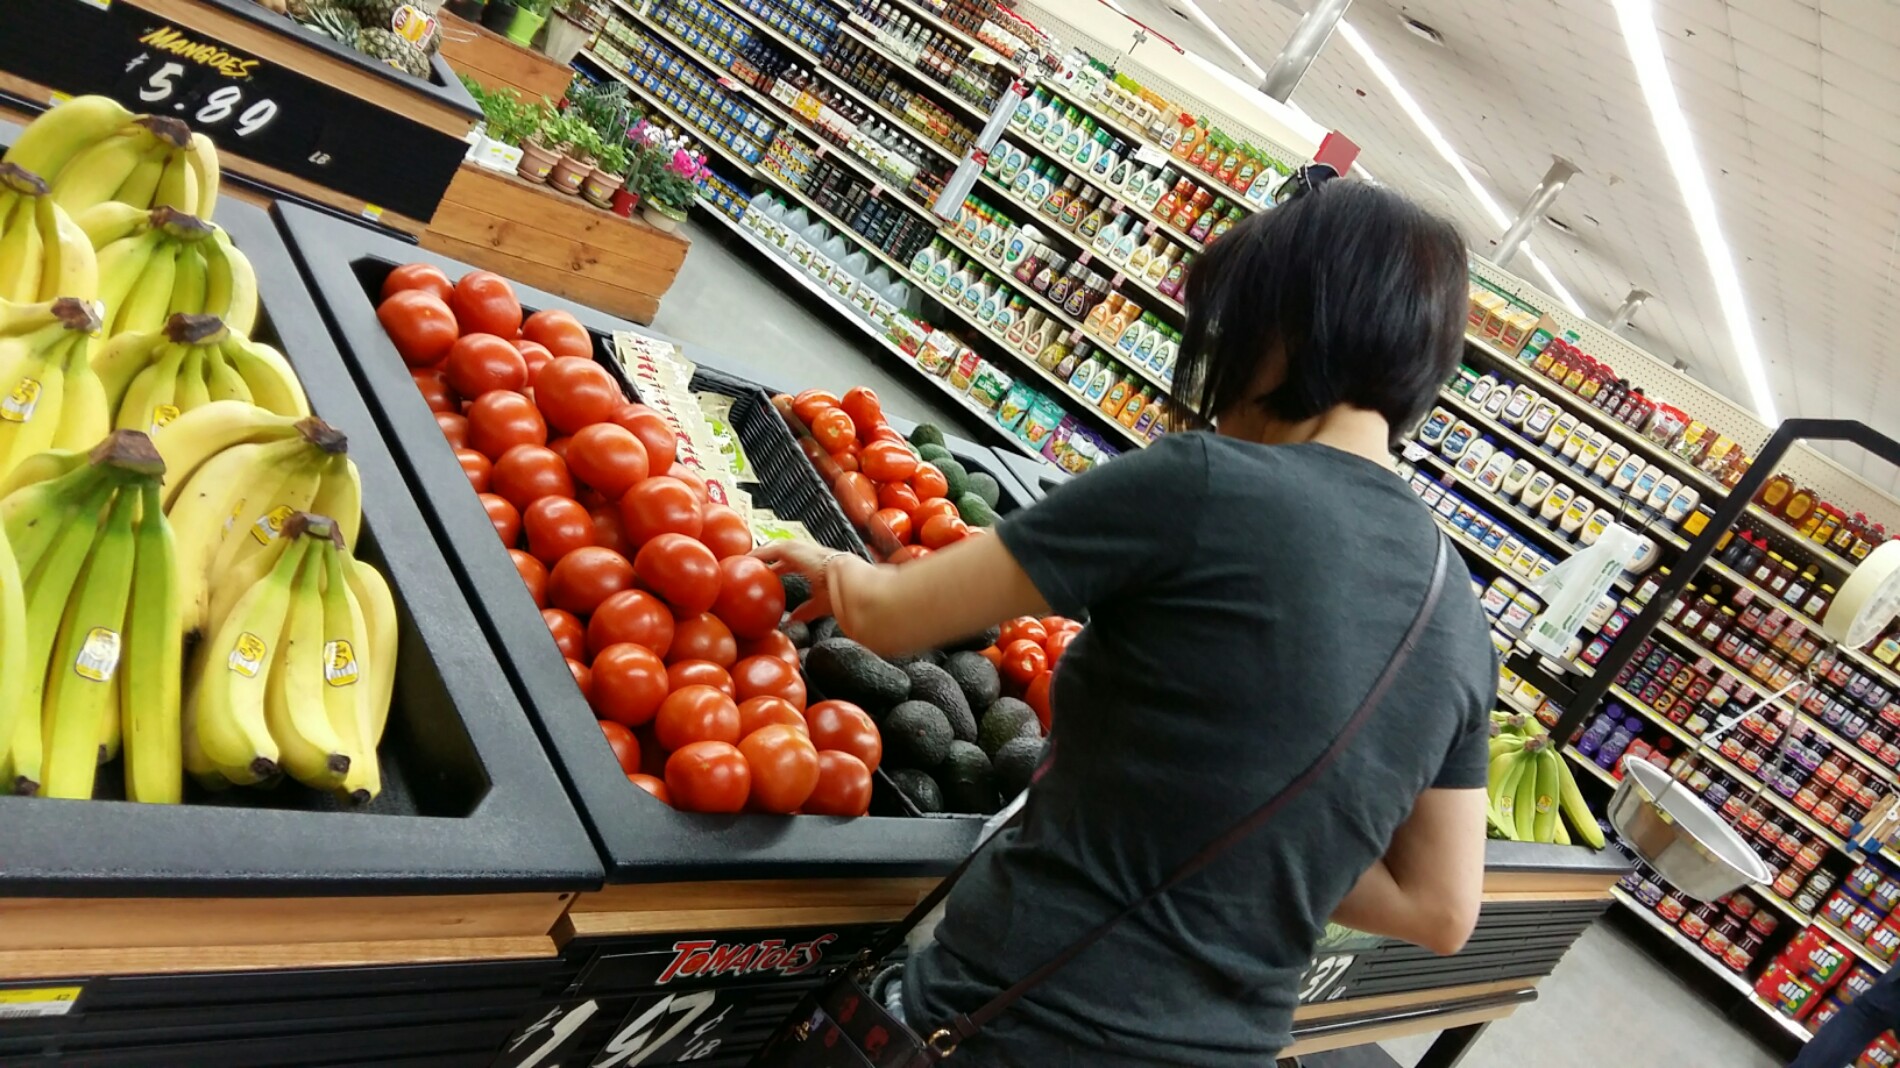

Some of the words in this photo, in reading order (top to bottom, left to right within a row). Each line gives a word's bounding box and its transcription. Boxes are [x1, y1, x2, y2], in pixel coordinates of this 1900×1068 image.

[139, 26, 260, 78] MANGOES
[308, 150, 333, 165] LB
[1852, 866, 1879, 884] Jif
[1829, 898, 1856, 916] Jif
[1851, 912, 1878, 931] Jif
[1872, 928, 1900, 948] Jif
[653, 933, 838, 986] TOMATOES
[1808, 949, 1837, 968] Jif
[1298, 955, 1354, 1002] 37
[1847, 975, 1872, 995] Jif
[1778, 981, 1806, 1000] Jif
[676, 1038, 722, 1062] LB
[1867, 1047, 1894, 1066] Jif
